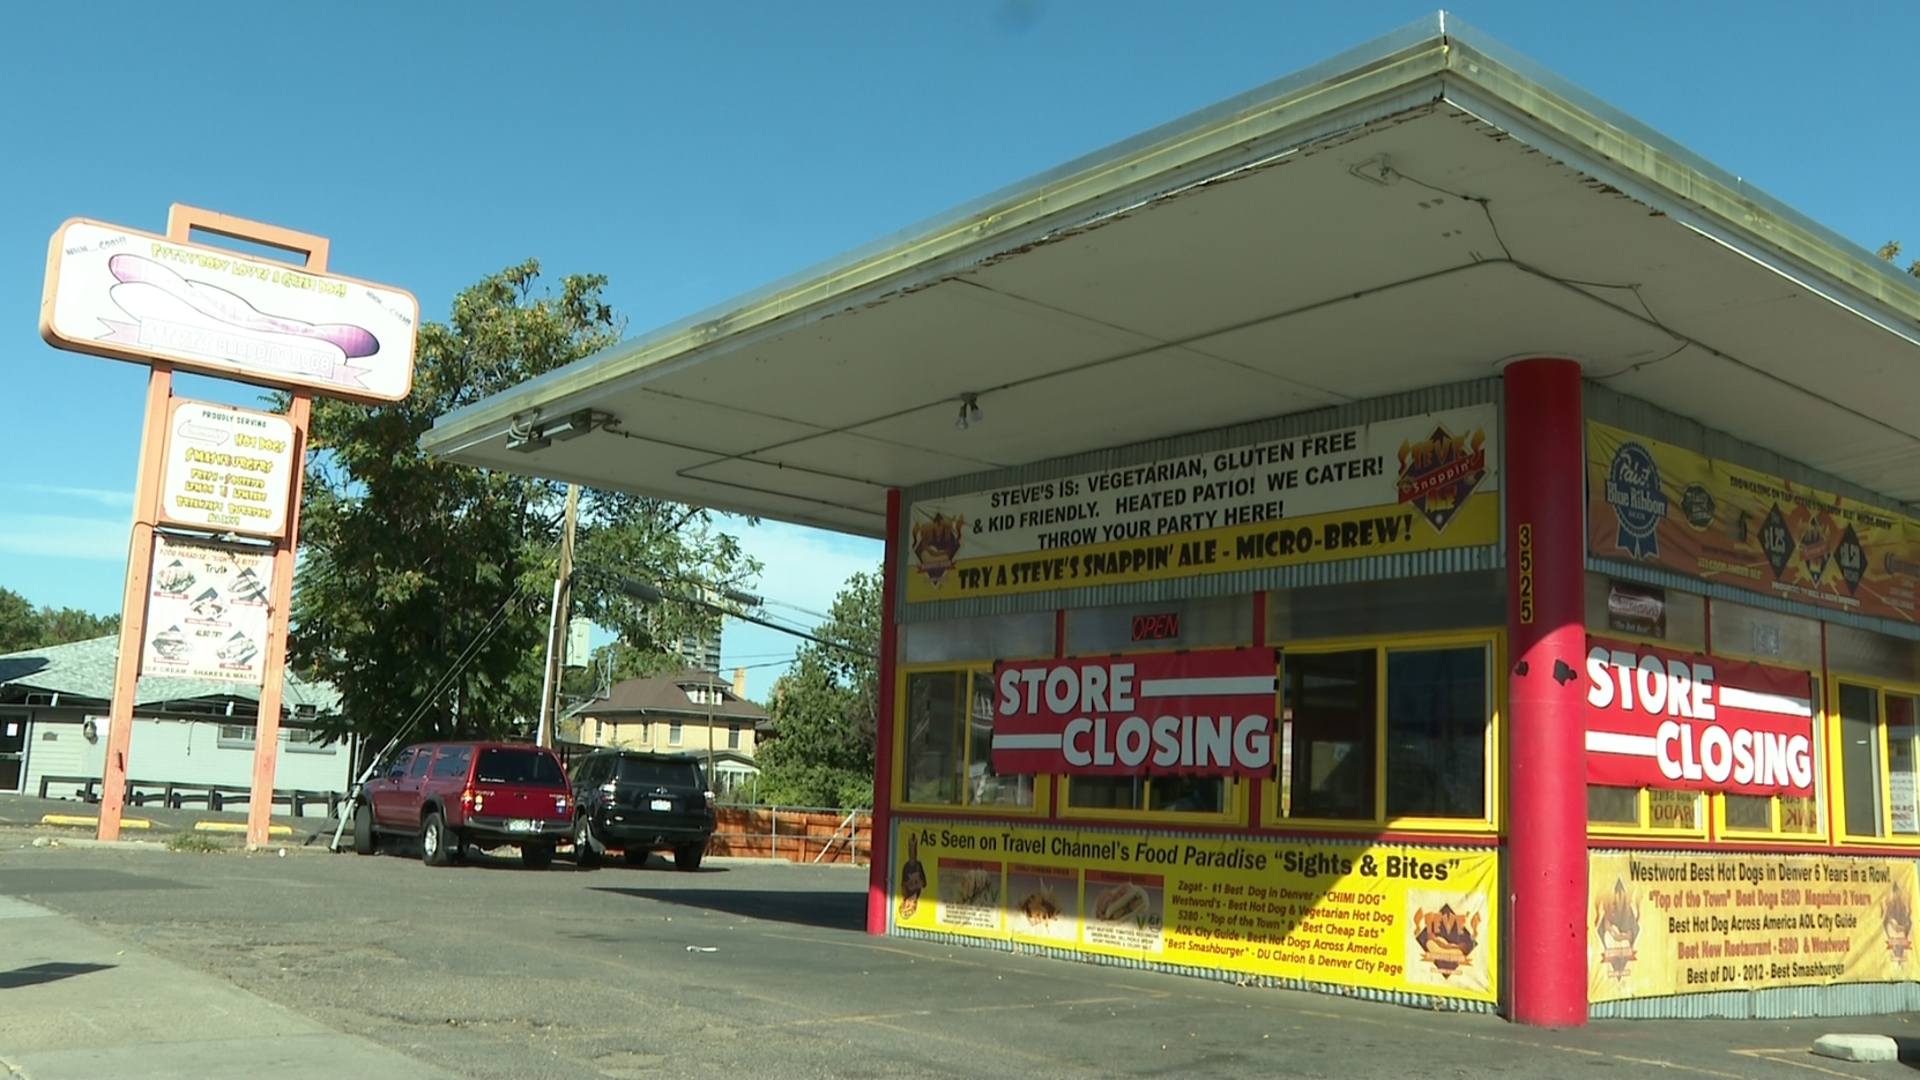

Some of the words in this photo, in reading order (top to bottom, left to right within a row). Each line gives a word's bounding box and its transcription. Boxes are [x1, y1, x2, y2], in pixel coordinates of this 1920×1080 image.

[202, 410, 234, 423] PROUDLY
[237, 416, 267, 429] SERVING
[234, 433, 257, 448] HOT
[258, 436, 286, 454] DOGS
[991, 483, 1054, 508] STEVE'S
[1060, 480, 1080, 498] IS:
[1087, 458, 1208, 493] VEGETARIAN,
[1213, 441, 1295, 473] GLUTEN
[1301, 430, 1357, 459] FREE
[1411, 458, 1473, 494] Snappin'
[972, 518, 983, 535] &
[988, 514, 1015, 533] KID
[1020, 501, 1100, 529] FRIENDLY.
[1115, 488, 1187, 515] HEATED
[1192, 476, 1256, 503] PATIO!
[1267, 470, 1298, 492] WE
[1305, 456, 1384, 486] CATER!
[1606, 480, 1629, 506] Blue
[1629, 486, 1666, 517] Ribbon
[1038, 526, 1097, 550] THROW
[1102, 519, 1151, 542] YOUR
[1157, 509, 1218, 536] PARTY
[1224, 500, 1284, 527] HERE!
[958, 564, 993, 590] TRY
[996, 563, 1007, 587] A
[1011, 555, 1079, 585] STEVE'S
[1083, 542, 1175, 578] SNAPPIN'
[1178, 538, 1217, 567] ALE
[1236, 513, 1413, 562] MICRO-BREW!
[1520, 525, 1532, 622] 3525
[1132, 613, 1178, 641] OPEN
[160, 665, 187, 674] CREAM
[193, 669, 224, 677] SHAKES
[233, 672, 258, 680] MALTS
[1585, 645, 1716, 721] STORE
[998, 662, 1136, 717] STORE
[1062, 714, 1271, 769] CLOSING
[1655, 720, 1814, 789] CLOSING
[919, 829, 937, 848] As
[941, 830, 976, 851] Seen
[980, 836, 997, 852] on
[1001, 832, 1047, 856] Travel
[1051, 837, 1131, 862] Channel's
[1135, 842, 1178, 865] Food
[1184, 846, 1267, 871] Paradise
[1360, 854, 1378, 878] &
[1629, 860, 1687, 882] Westword
[1690, 862, 1715, 882] Best
[1717, 862, 1736, 882] Hot
[1739, 862, 1764, 886] Dogs
[1766, 863, 1776, 881] in
[1778, 863, 1813, 882] Denver
[1814, 863, 1821, 882] 6
[1822, 864, 1849, 883] Years
[1850, 865, 1859, 883] in
[1861, 870, 1867, 883] a
[1868, 866, 1892, 883] Row!
[1178, 880, 1203, 894] Zagat
[1224, 883, 1244, 896] Best
[1247, 886, 1267, 900] Dog
[1269, 886, 1278, 899] in
[1279, 888, 1314, 901] Denver
[1673, 889, 1684, 908] of
[1685, 889, 1701, 908] the
[1757, 889, 1779, 910] Dogs
[1805, 889, 1841, 910] Magazine
[1842, 890, 1848, 906] 2
[1849, 890, 1872, 906] Years
[1172, 894, 1221, 909] Westword's
[1228, 899, 1247, 911] Best
[1249, 900, 1266, 912] Hot
[1267, 903, 1287, 918] Dog
[1288, 904, 1296, 914] &
[1298, 904, 1350, 921] Vegetarian
[1352, 909, 1371, 922] Hot
[1373, 910, 1395, 926] Dog
[1177, 909, 1199, 922] 5280
[1227, 914, 1238, 926] of
[1239, 915, 1254, 928] the
[1325, 923, 1355, 939] Cheap
[1668, 917, 1690, 934] Best
[1692, 916, 1709, 933] Hot
[1711, 915, 1729, 935] Dog
[1731, 914, 1761, 931] Across
[1762, 913, 1797, 931] America
[1799, 914, 1815, 930] AOL
[1817, 913, 1833, 932] City
[1834, 912, 1858, 929] Guide
[1175, 924, 1193, 936] AOL
[1195, 926, 1212, 940] City
[1213, 928, 1240, 941] Guide
[1247, 931, 1267, 944] Best
[1268, 933, 1286, 945] Hot
[1287, 936, 1311, 951] Dogs
[1313, 940, 1344, 953] Across
[1346, 943, 1388, 956] America
[1701, 940, 1722, 959] New
[1724, 938, 1772, 958] Restaurant
[1811, 936, 1851, 953] Westword
[1257, 948, 1271, 960] DU
[1273, 950, 1306, 964] Clarion
[1308, 955, 1316, 965] &
[1317, 955, 1353, 969] Denver
[1354, 958, 1376, 974] City
[1377, 961, 1403, 976] Page
[1686, 967, 1709, 985] Best
[1709, 965, 1720, 982] of
[1721, 965, 1736, 982] DU
[1742, 963, 1764, 981] 2012
[1770, 962, 1791, 979] Best
[1792, 961, 1845, 980] Smashburger
